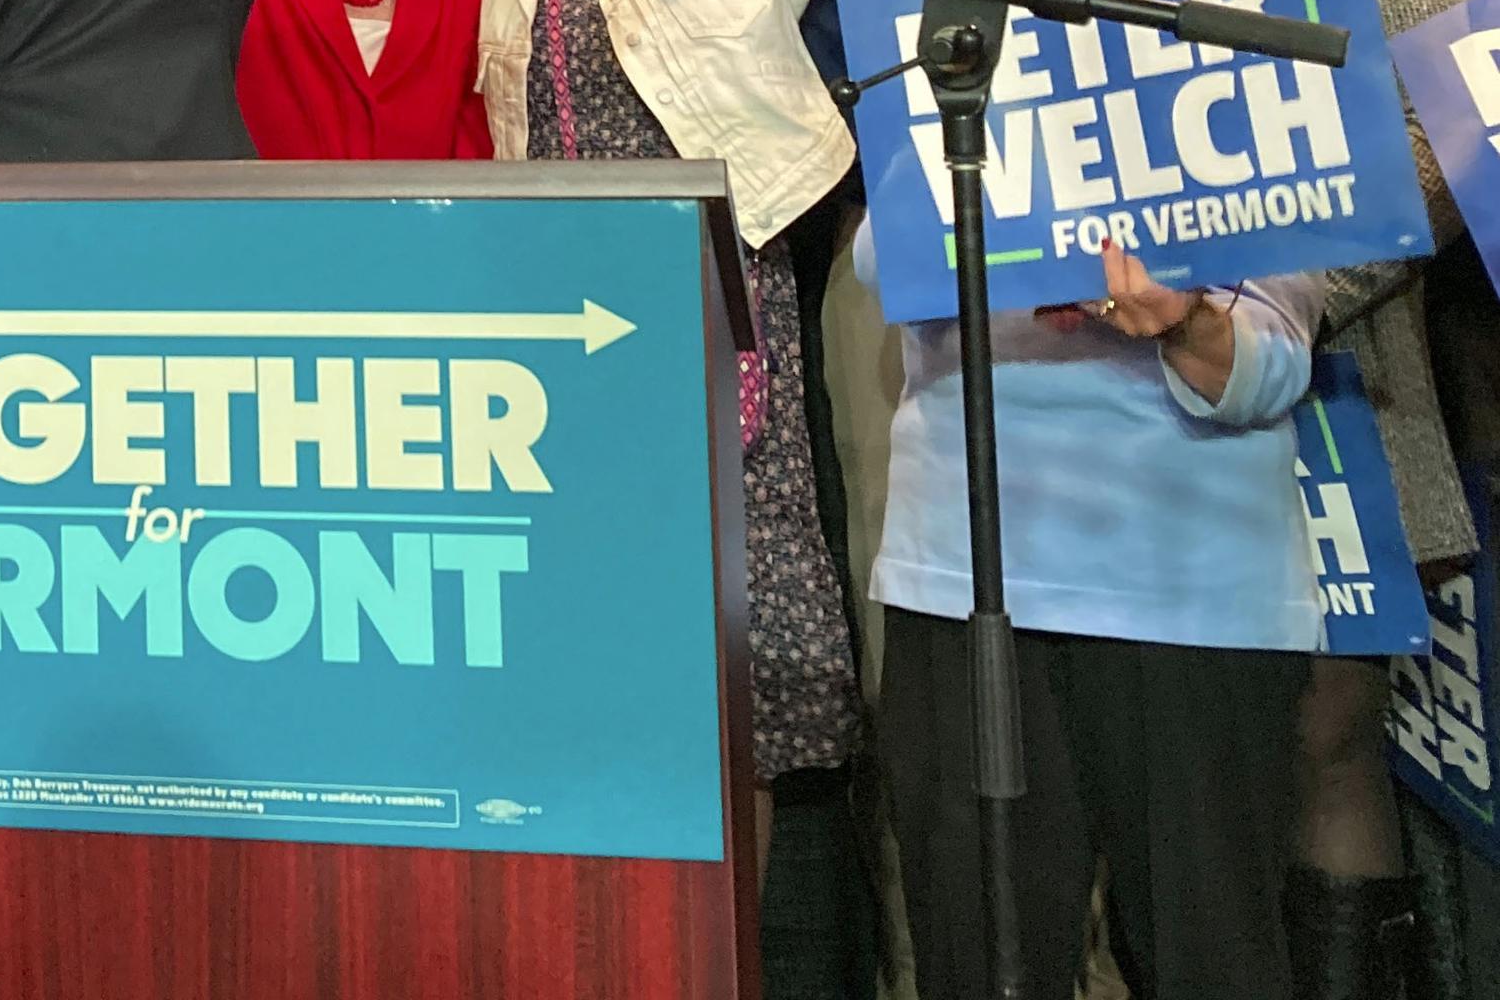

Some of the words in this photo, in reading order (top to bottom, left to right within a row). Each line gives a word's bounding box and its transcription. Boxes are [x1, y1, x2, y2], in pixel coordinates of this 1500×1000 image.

[908, 61, 1351, 224] WELCH
[1052, 213, 1137, 258] FOR
[1142, 174, 1356, 246] VERMONT
[125, 485, 205, 543] for
[1432, 574, 1491, 790] ETER
[96, 793, 110, 804] VT
[214, 786, 228, 799] by
